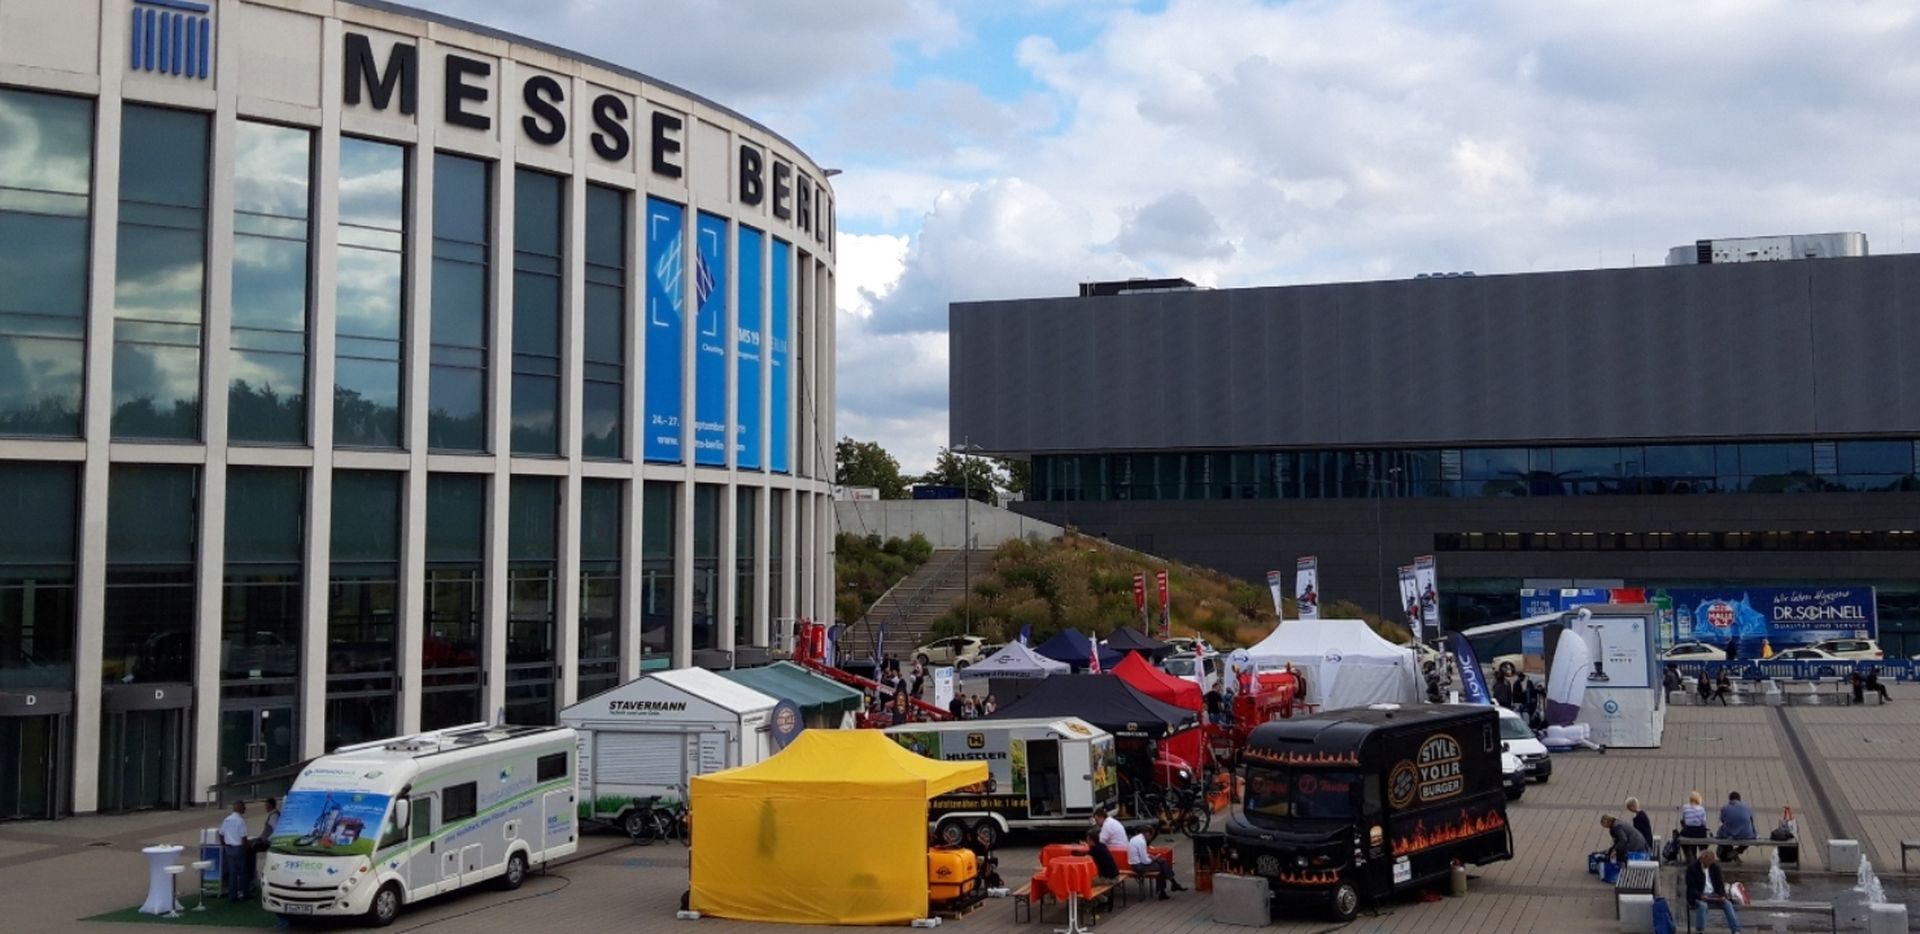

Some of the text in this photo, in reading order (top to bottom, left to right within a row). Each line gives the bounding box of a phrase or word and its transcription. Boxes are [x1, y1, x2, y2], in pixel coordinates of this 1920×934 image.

[344, 31, 832, 253] MESSE BERLI
[26, 695, 36, 706] D
[154, 689, 164, 700] D
[609, 701, 687, 711] STAVERMANN
[946, 752, 1007, 761] HUSTLER
[1422, 739, 1457, 762] STYLE
[1421, 762, 1459, 781] YOUR
[1422, 780, 1460, 797] BURGER
